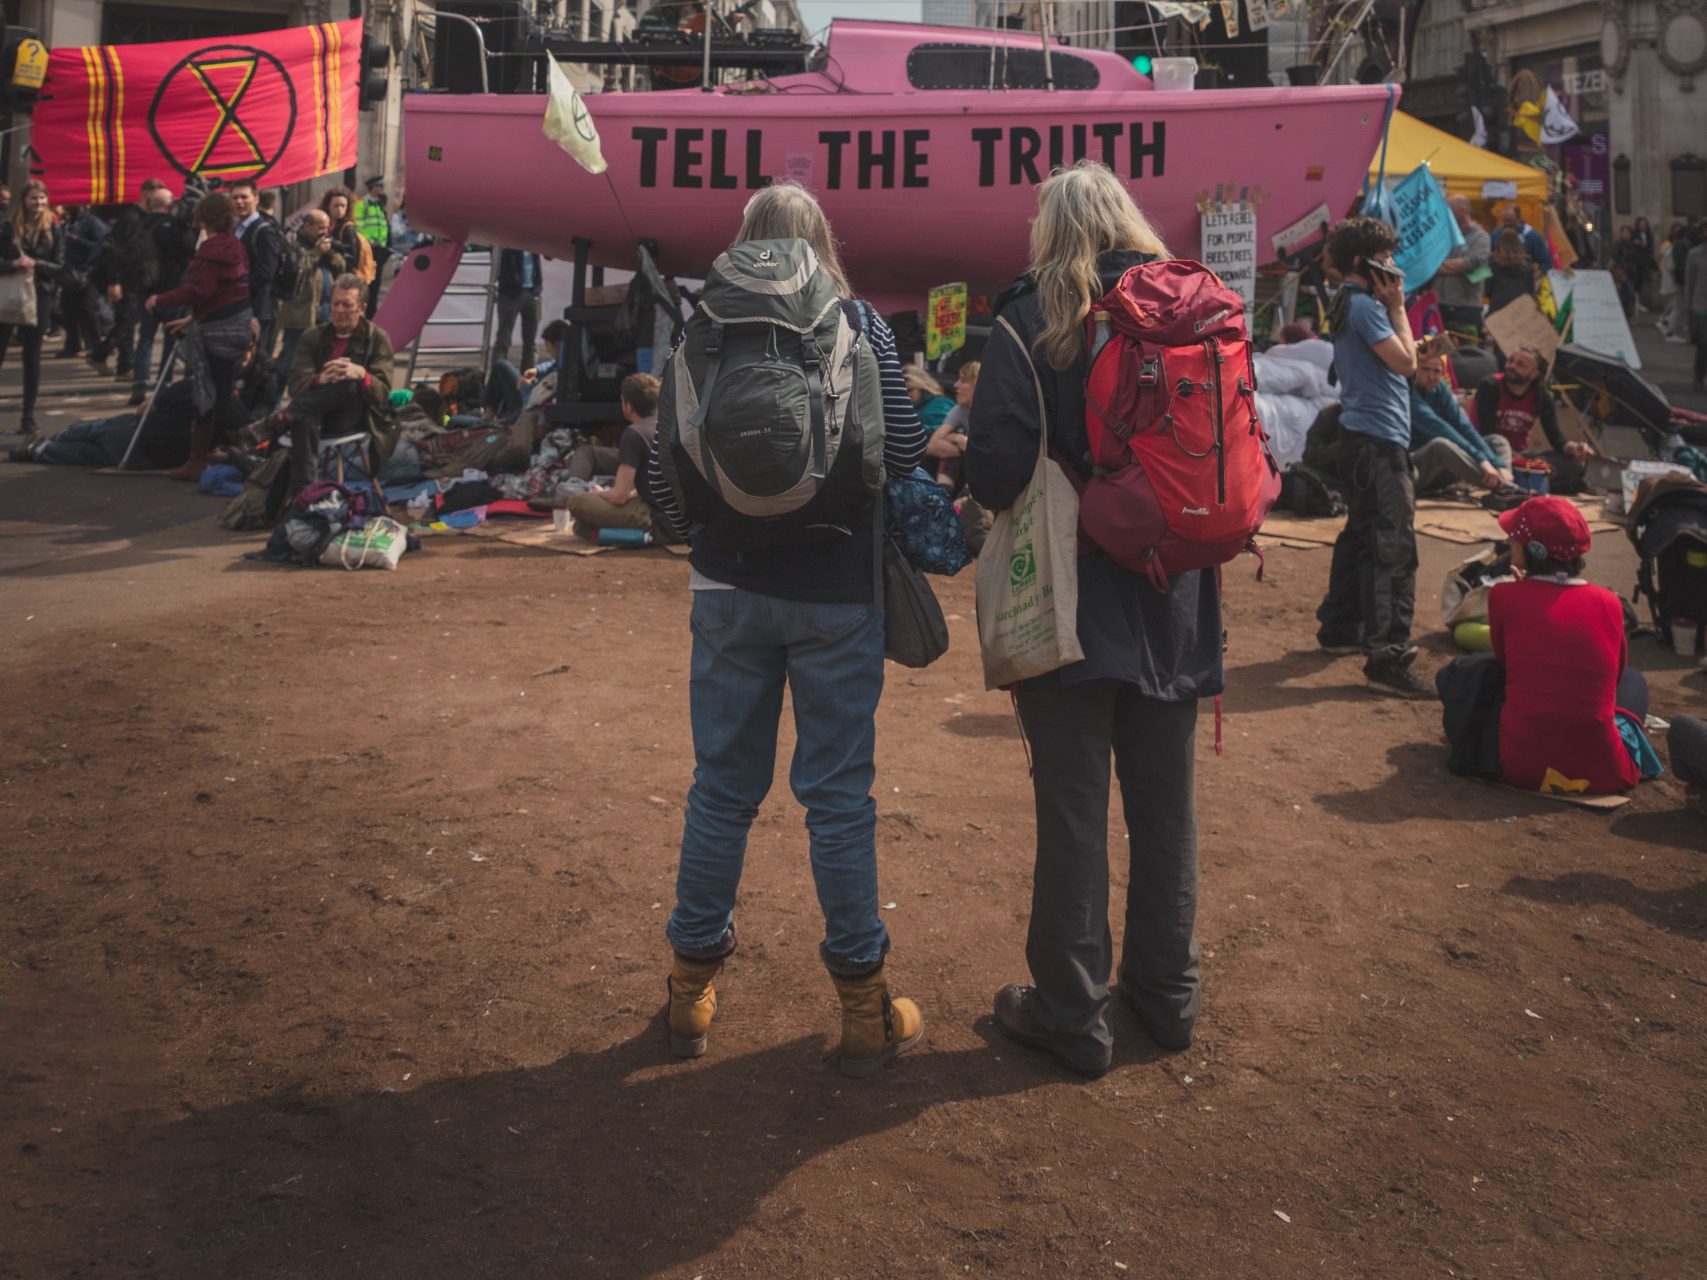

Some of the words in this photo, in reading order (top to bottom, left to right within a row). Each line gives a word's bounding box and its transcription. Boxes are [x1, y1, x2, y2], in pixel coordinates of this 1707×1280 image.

[631, 127, 772, 189] TELL
[818, 130, 930, 189] THE
[972, 121, 1167, 187] TRUTH
[1207, 233, 1224, 246] FOR
